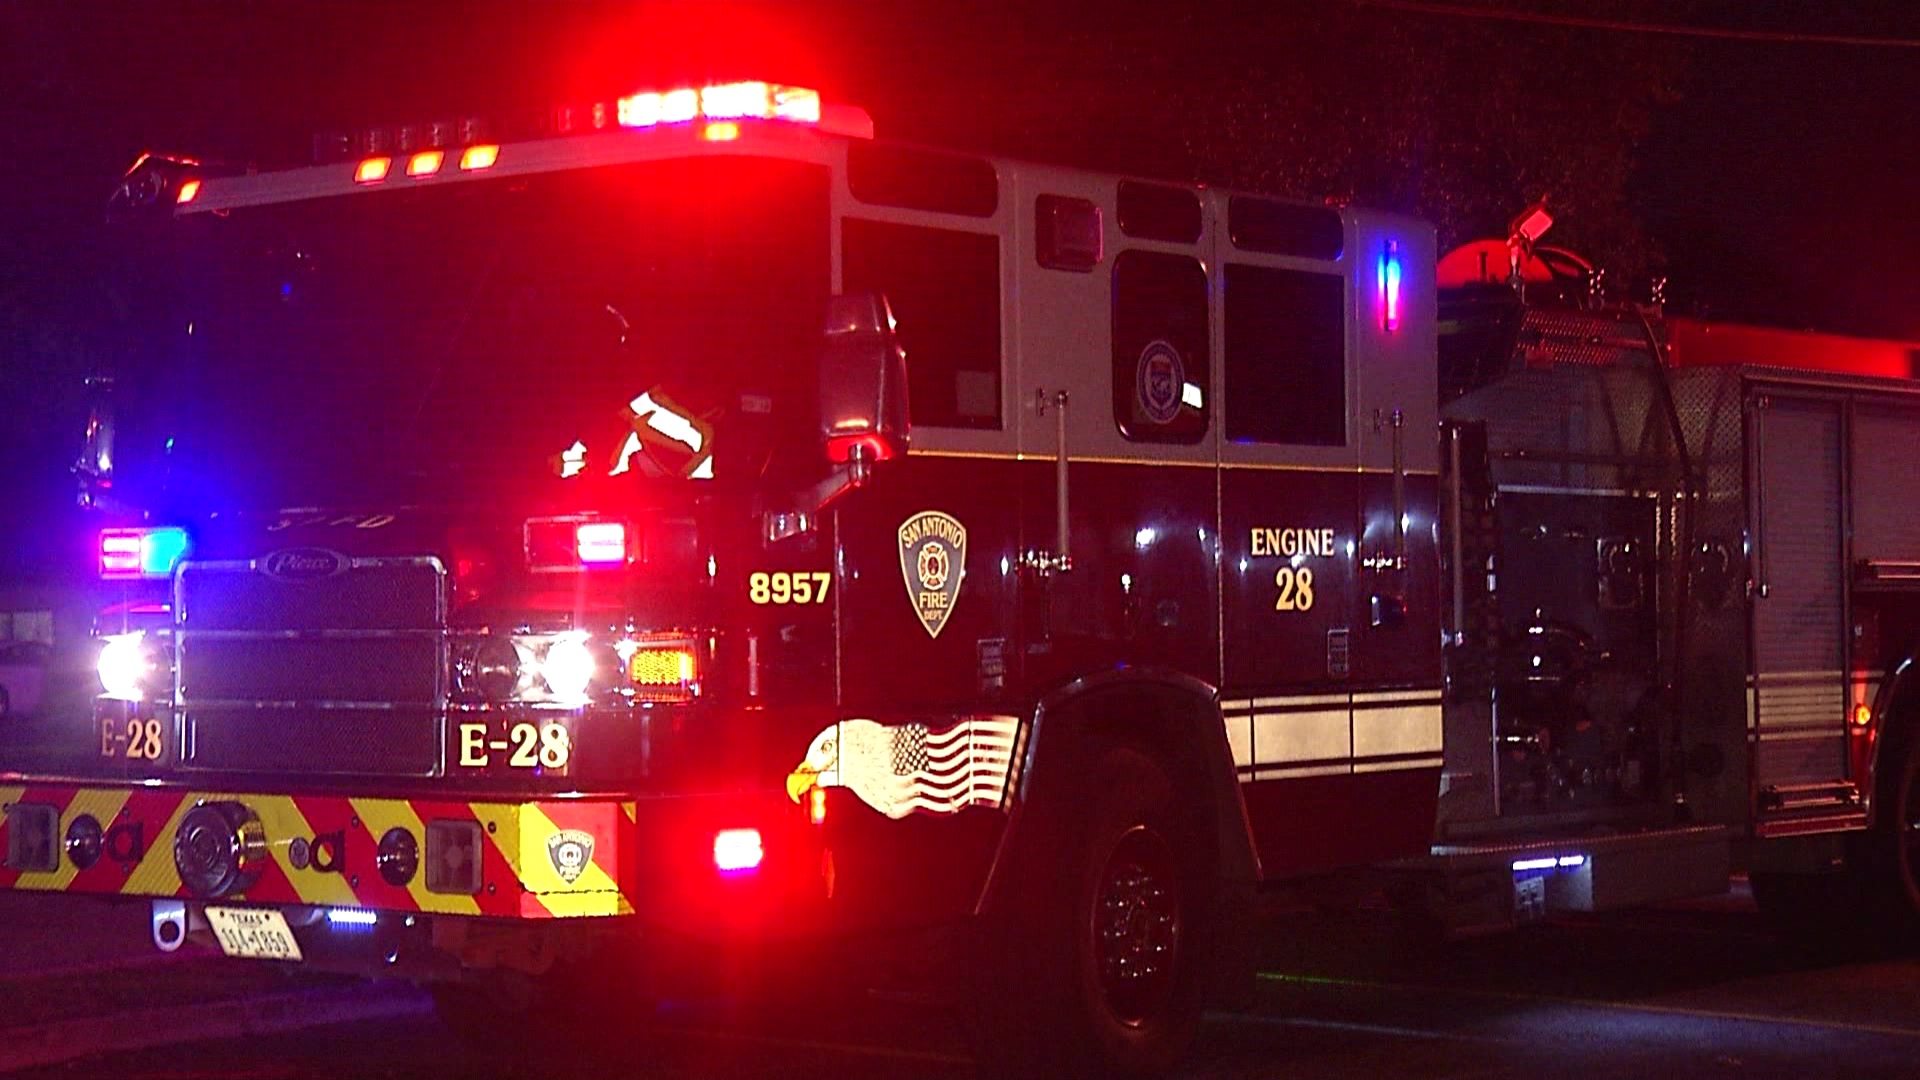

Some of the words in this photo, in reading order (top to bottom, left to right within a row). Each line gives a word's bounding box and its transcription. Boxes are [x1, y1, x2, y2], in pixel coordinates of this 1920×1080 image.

[902, 520, 921, 548] SAN
[922, 517, 963, 549] ANTONIO
[1251, 528, 1335, 556] ENGINE
[749, 572, 831, 604] 8957
[919, 592, 948, 608] FIRE
[1275, 566, 1313, 611] 28
[101, 718, 162, 759] E-28
[459, 723, 569, 768] E-28
[230, 912, 263, 924] TEXAS
